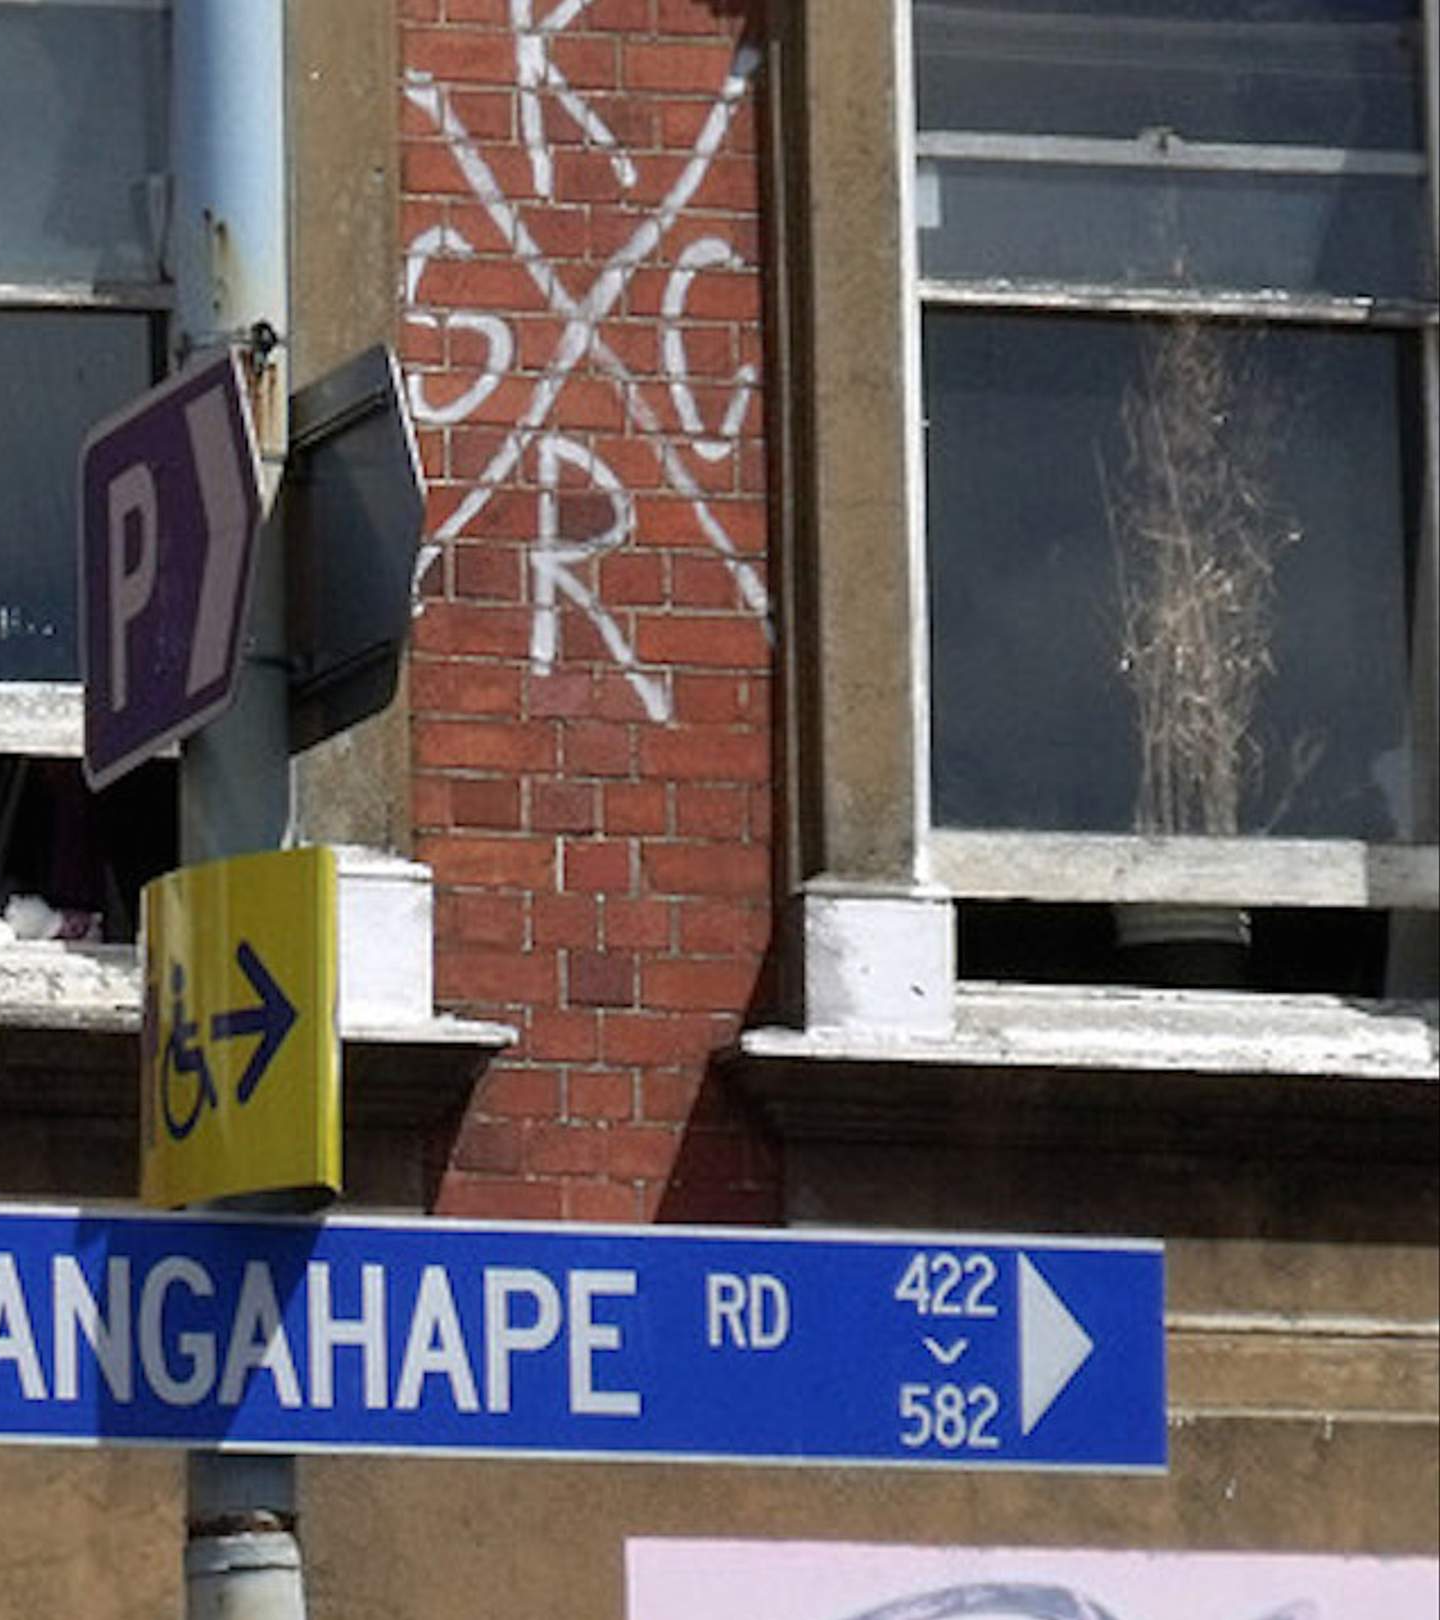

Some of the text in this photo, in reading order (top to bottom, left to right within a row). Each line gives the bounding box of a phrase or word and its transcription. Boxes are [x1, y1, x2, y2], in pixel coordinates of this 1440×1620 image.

[108, 463, 158, 713] P
[530, 435, 674, 723] R
[705, 1273, 791, 1350] RD
[894, 1252, 999, 1318] 422
[898, 1382, 1001, 1450] 582
